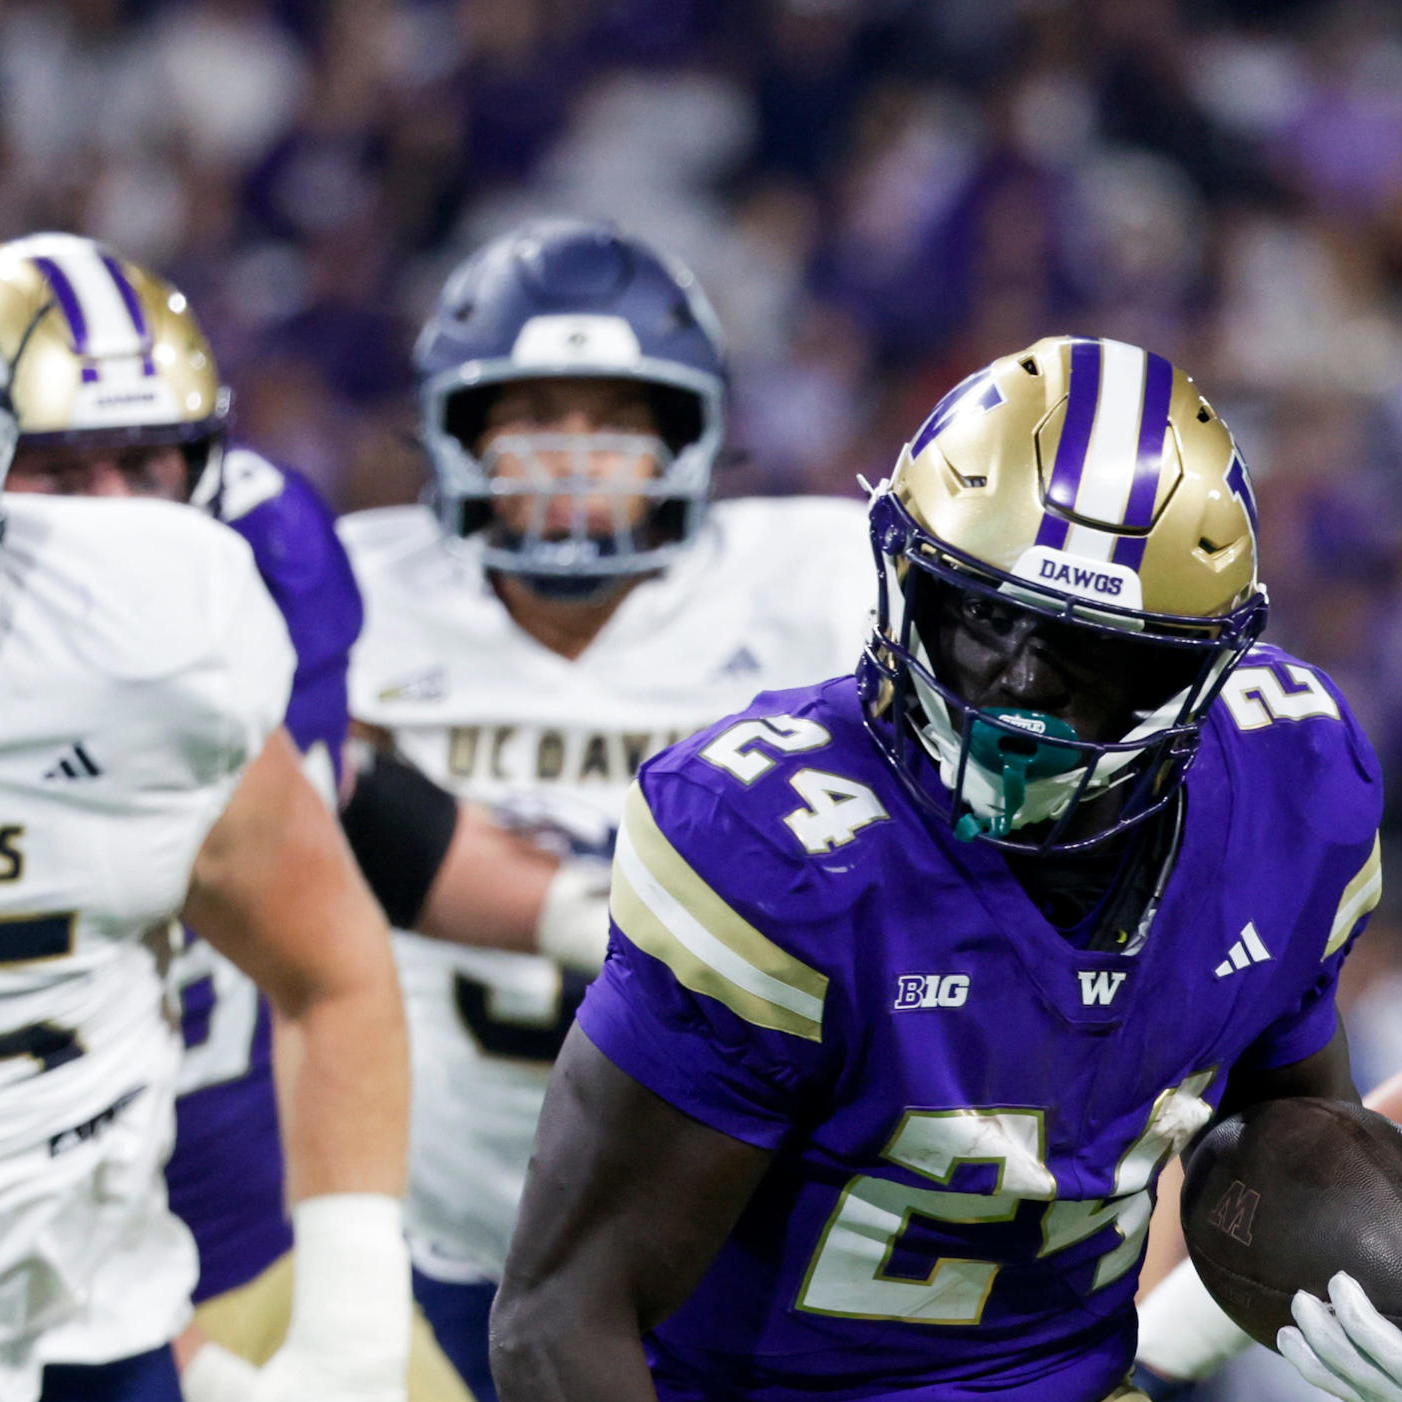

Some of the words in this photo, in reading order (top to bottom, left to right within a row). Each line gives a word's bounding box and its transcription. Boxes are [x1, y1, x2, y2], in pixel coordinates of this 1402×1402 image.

[1039, 559, 1124, 596] DAWGS
[1220, 642, 1343, 731] 2
[535, 728, 678, 782] DAV
[699, 713, 890, 855] 24
[894, 975, 970, 1010] BIG
[1078, 971, 1127, 1006] W
[795, 1066, 1218, 1326] 24
